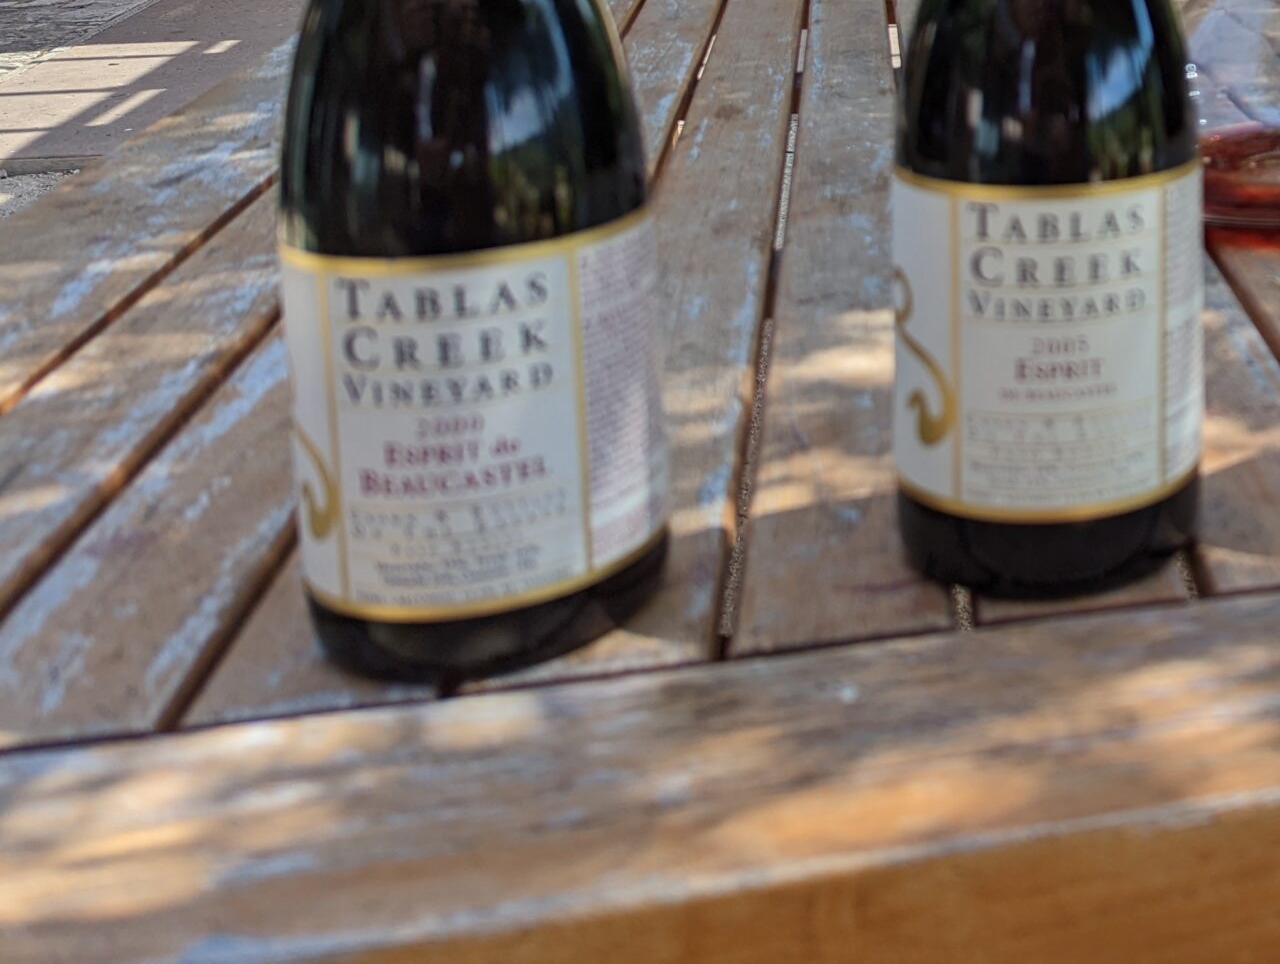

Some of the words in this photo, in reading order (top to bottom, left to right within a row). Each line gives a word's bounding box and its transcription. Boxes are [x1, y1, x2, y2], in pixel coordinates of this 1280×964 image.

[966, 200, 1145, 242] TABLAS
[969, 246, 1142, 288] CREEK
[335, 271, 549, 322] TABLAS
[967, 288, 1147, 320] VINEYARD
[342, 320, 550, 372] CREEK
[342, 362, 554, 408] VINEYARD
